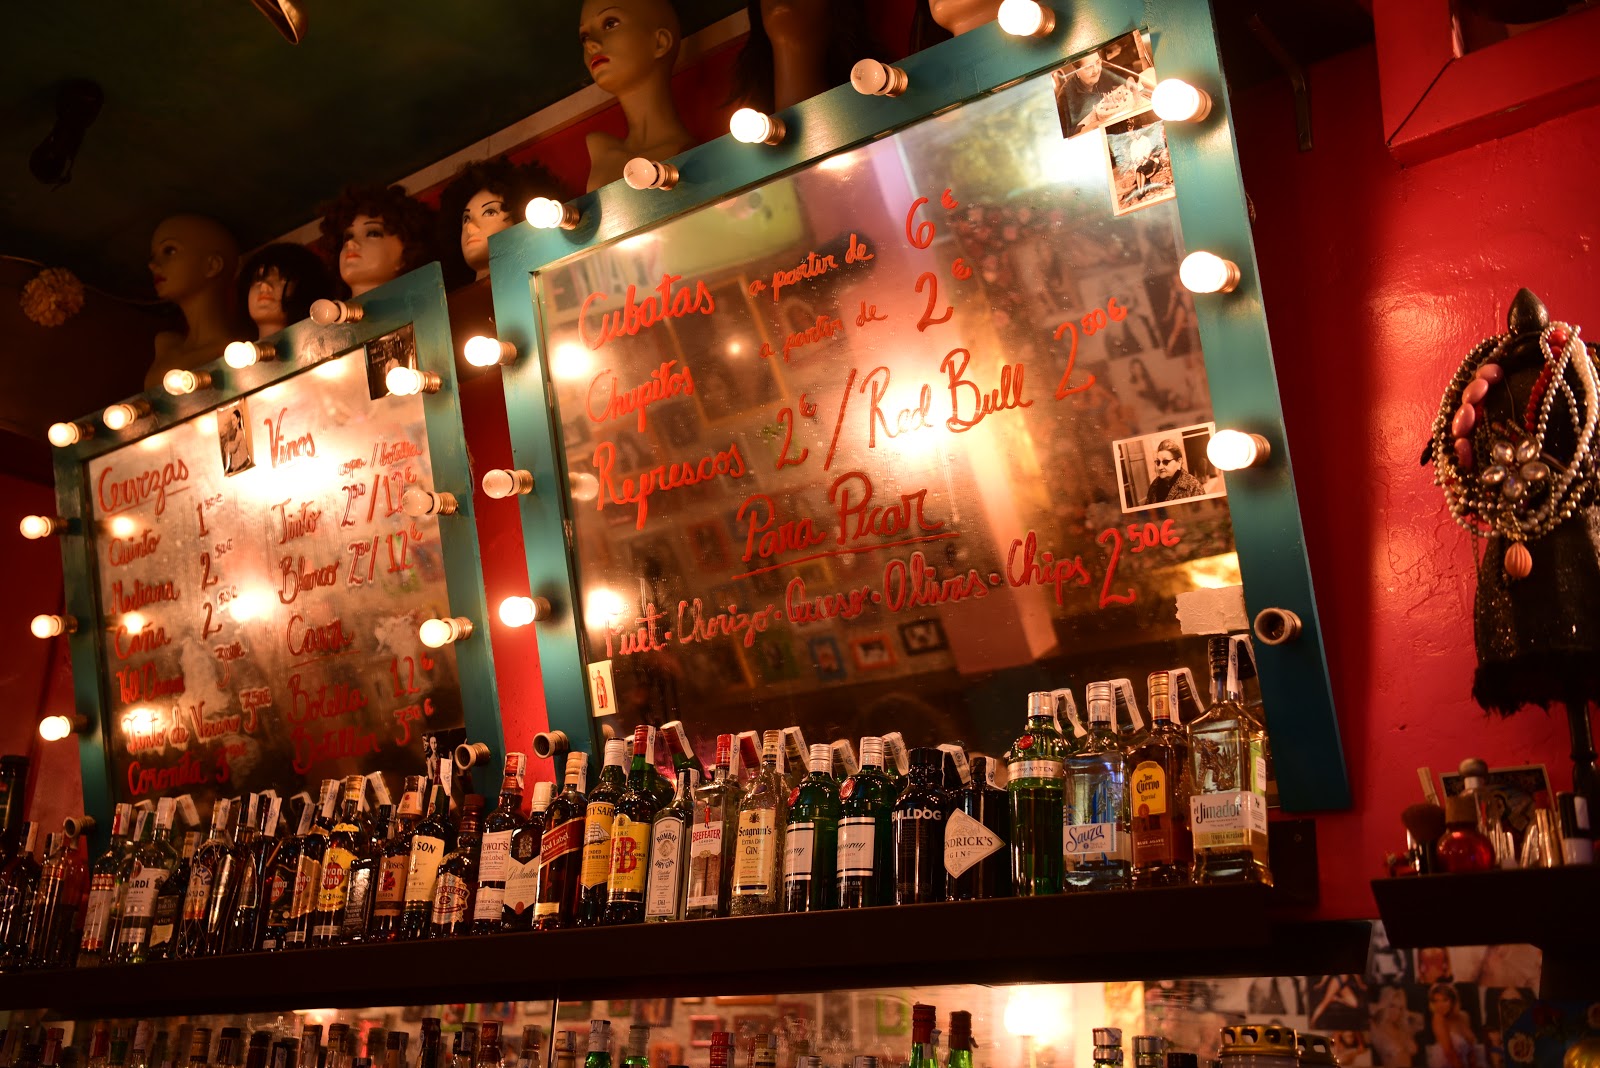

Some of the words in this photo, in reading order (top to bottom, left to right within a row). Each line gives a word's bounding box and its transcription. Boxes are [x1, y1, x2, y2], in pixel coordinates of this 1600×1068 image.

[578, 272, 716, 351] Cubatas
[749, 279, 767, 296] a
[772, 250, 839, 302] partir
[844, 233, 875, 264] de
[585, 359, 696, 433] Chupitos
[758, 341, 776, 359] a
[783, 314, 844, 363] partir
[855, 300, 889, 328] de
[263, 406, 319, 469] Vinos
[592, 440, 747, 531] Refrescos
[860, 366, 934, 449] Red
[939, 347, 1034, 433] Bull
[97, 458, 190, 517] Cervezas
[271, 497, 322, 545] Tinto
[735, 493, 828, 563] Para
[828, 470, 945, 546] Picar
[278, 555, 341, 605] Blanco
[1005, 530, 1092, 607] Chips
[114, 621, 172, 660] Caña
[286, 614, 354, 657] Cava
[287, 673, 370, 725] Botella
[127, 750, 209, 797] Coronita
[1136, 779, 1161, 794] Cuervo
[692, 828, 721, 843] BEEFEATER
[738, 825, 772, 839] Seagram's
[891, 807, 942, 823] BULLDOG
[1195, 799, 1242, 825] Jimador
[655, 832, 678, 844] BOMBAY
[1065, 824, 1105, 853] Sauza
